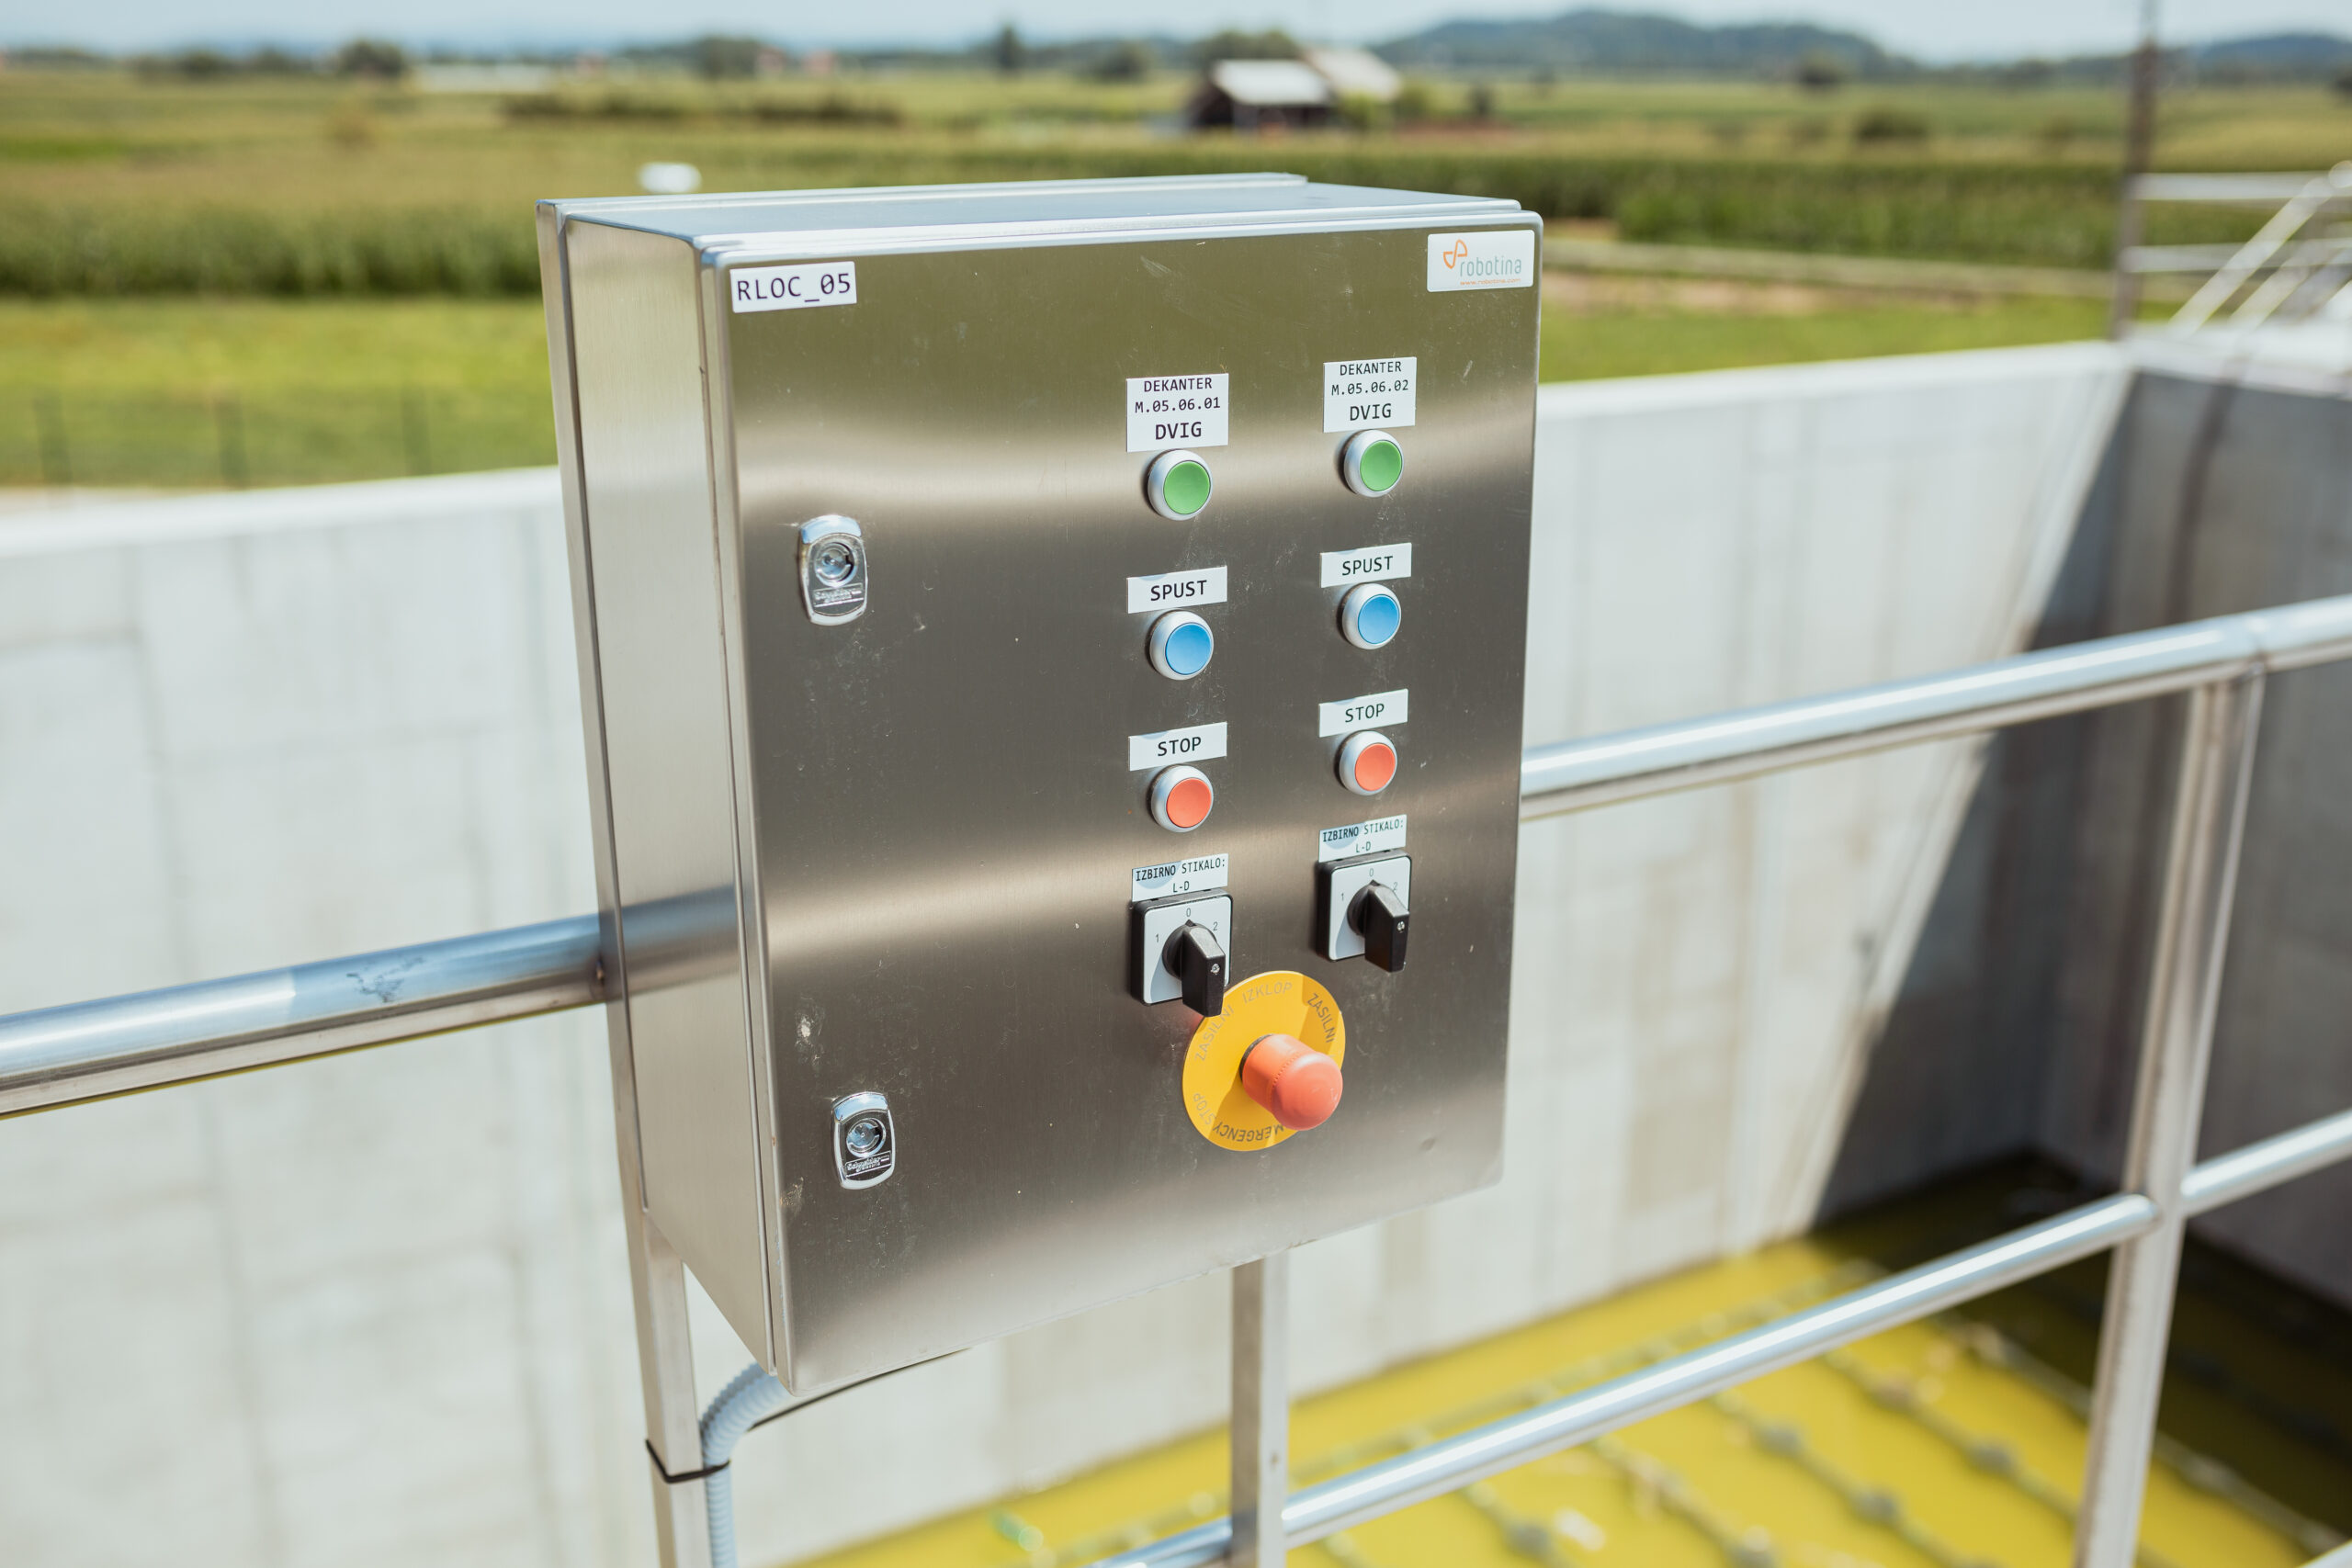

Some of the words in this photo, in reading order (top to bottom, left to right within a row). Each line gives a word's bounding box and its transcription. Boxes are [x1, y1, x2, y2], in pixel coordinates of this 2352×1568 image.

[1460, 255, 1521, 277] robotina
[737, 273, 851, 302] RLOC_05
[1340, 361, 1402, 376] DEKANTER
[1144, 378, 1213, 392] DEKANTER
[1331, 379, 1409, 396] M.05.06.02
[1135, 397, 1221, 413] M.05.06.01
[1350, 403, 1392, 421] DVIG
[1155, 422, 1202, 440] DVIG
[1341, 556, 1394, 576] SPUST
[1150, 580, 1207, 602] SPUST
[1345, 703, 1385, 723] STOP
[1158, 736, 1202, 757] STOP
[1322, 826, 1360, 843] IZBIRNO
[1363, 818, 1405, 835] STIKALO:
[1355, 840, 1372, 853] L-D
[1136, 864, 1177, 882] IZBIRNO
[1182, 857, 1226, 874] STIKALO:
[1369, 868, 1374, 877] 0
[1172, 880, 1190, 893] L-D
[1393, 882, 1398, 891] 2
[1186, 908, 1192, 918] 0
[1213, 921, 1218, 931] 2
[1155, 933, 1159, 943] 1
[1195, 1004, 1235, 1062] ZASILNI
[1241, 981, 1294, 1005] IZKLOP
[1306, 993, 1336, 1044] ZASILNI
[1193, 1092, 1216, 1125] STOP
[1213, 1122, 1284, 1142] MERGENCY
